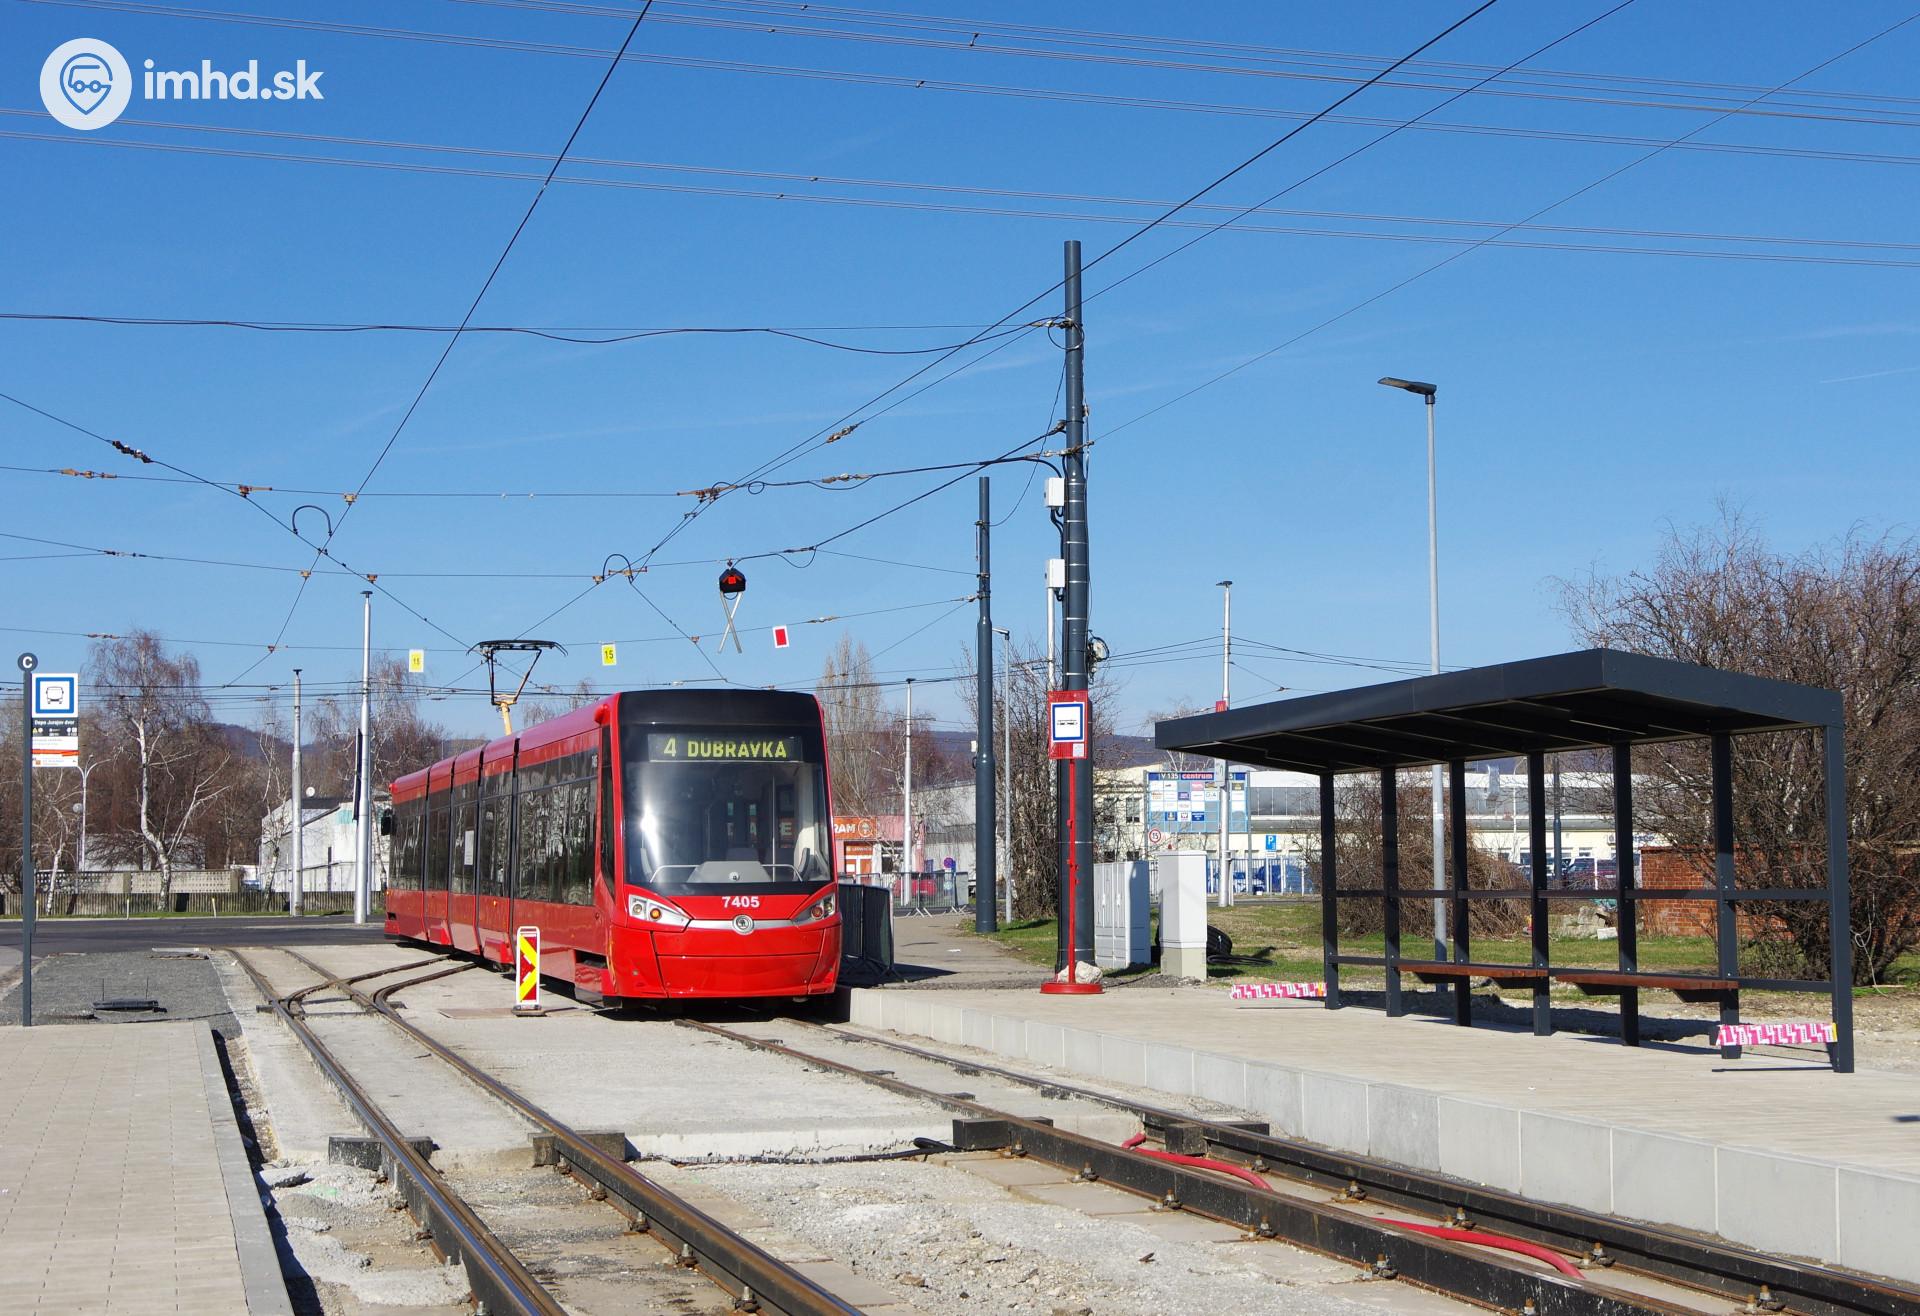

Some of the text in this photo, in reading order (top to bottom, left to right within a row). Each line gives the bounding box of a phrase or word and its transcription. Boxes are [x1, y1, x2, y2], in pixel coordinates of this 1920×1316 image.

[604, 650, 614, 660] 15
[22, 656, 33, 668] C
[663, 737, 677, 757] 4
[1152, 832, 1159, 840] 15
[1268, 836, 1274, 845] P
[722, 896, 760, 909] 7405
